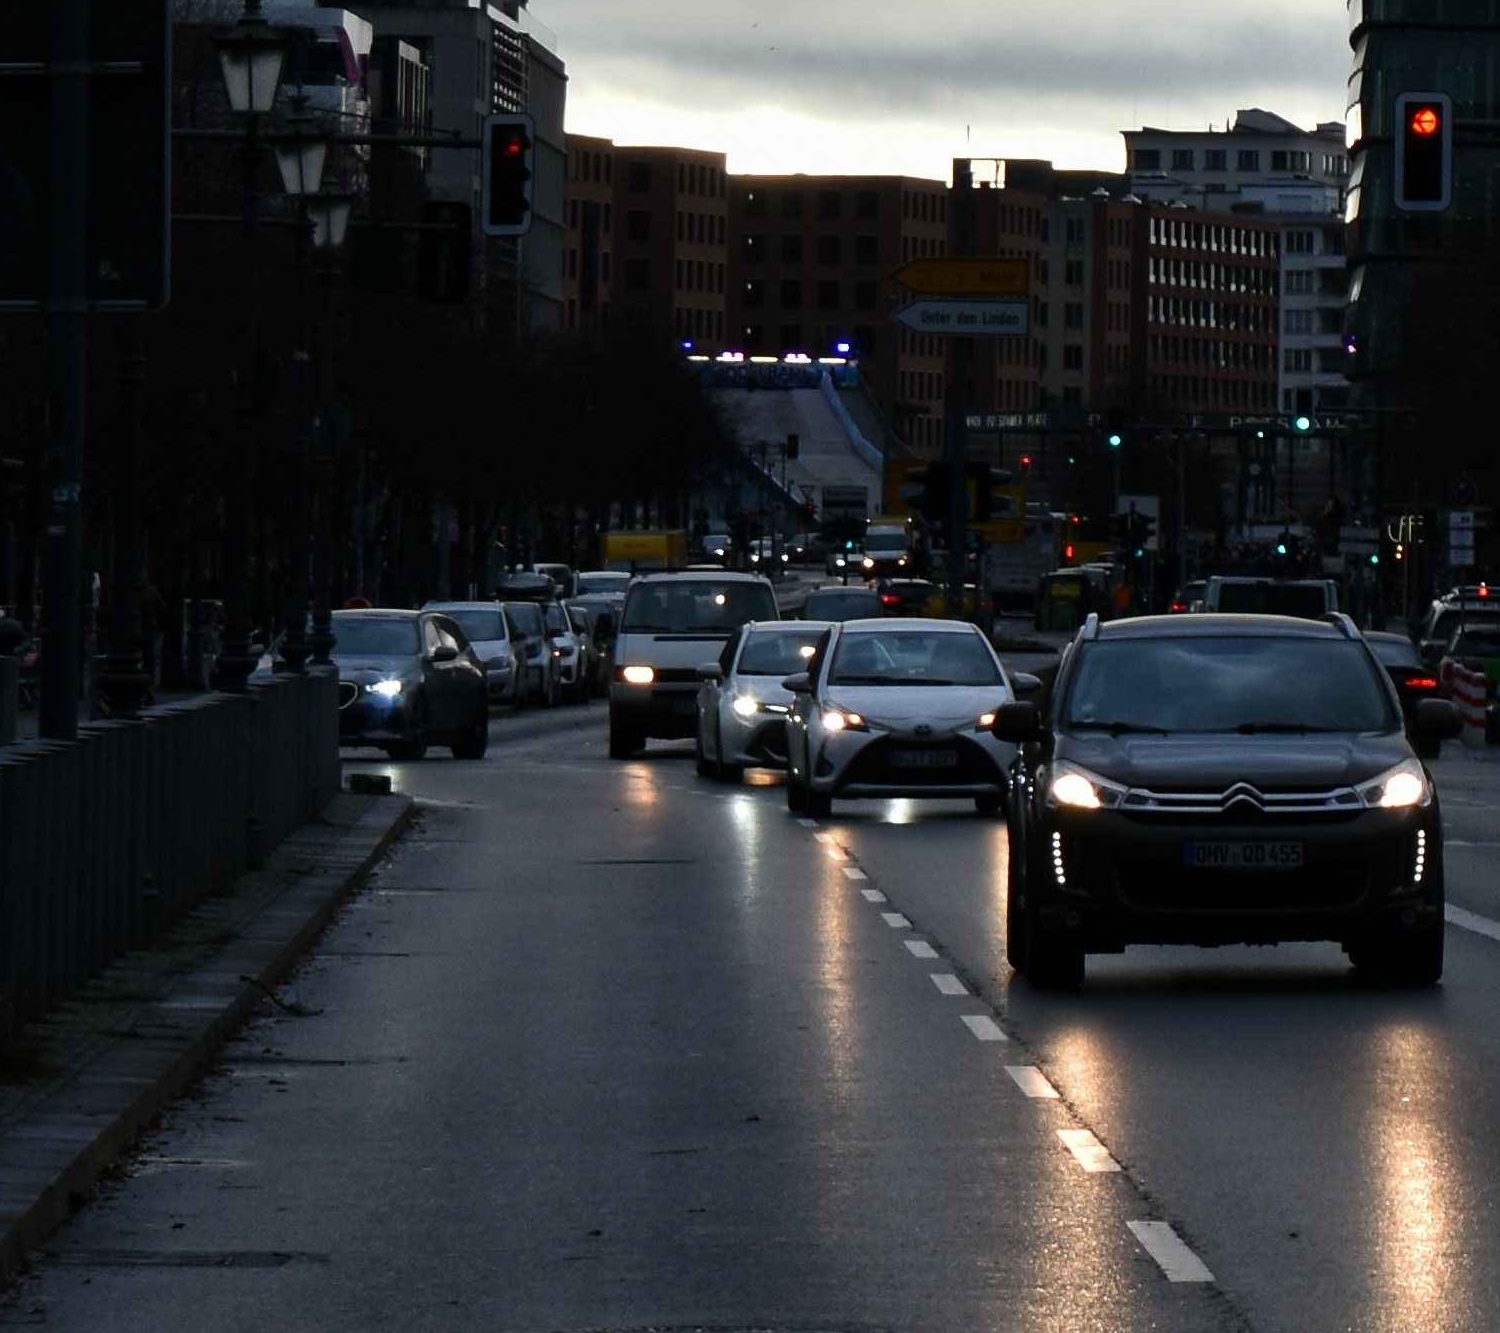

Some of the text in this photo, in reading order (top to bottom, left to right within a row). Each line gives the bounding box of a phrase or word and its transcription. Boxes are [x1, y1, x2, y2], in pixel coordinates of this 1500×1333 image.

[921, 310, 1020, 325] Unter den Linden
[1196, 844, 1229, 863] OHV
[1268, 845, 1301, 863] 455
